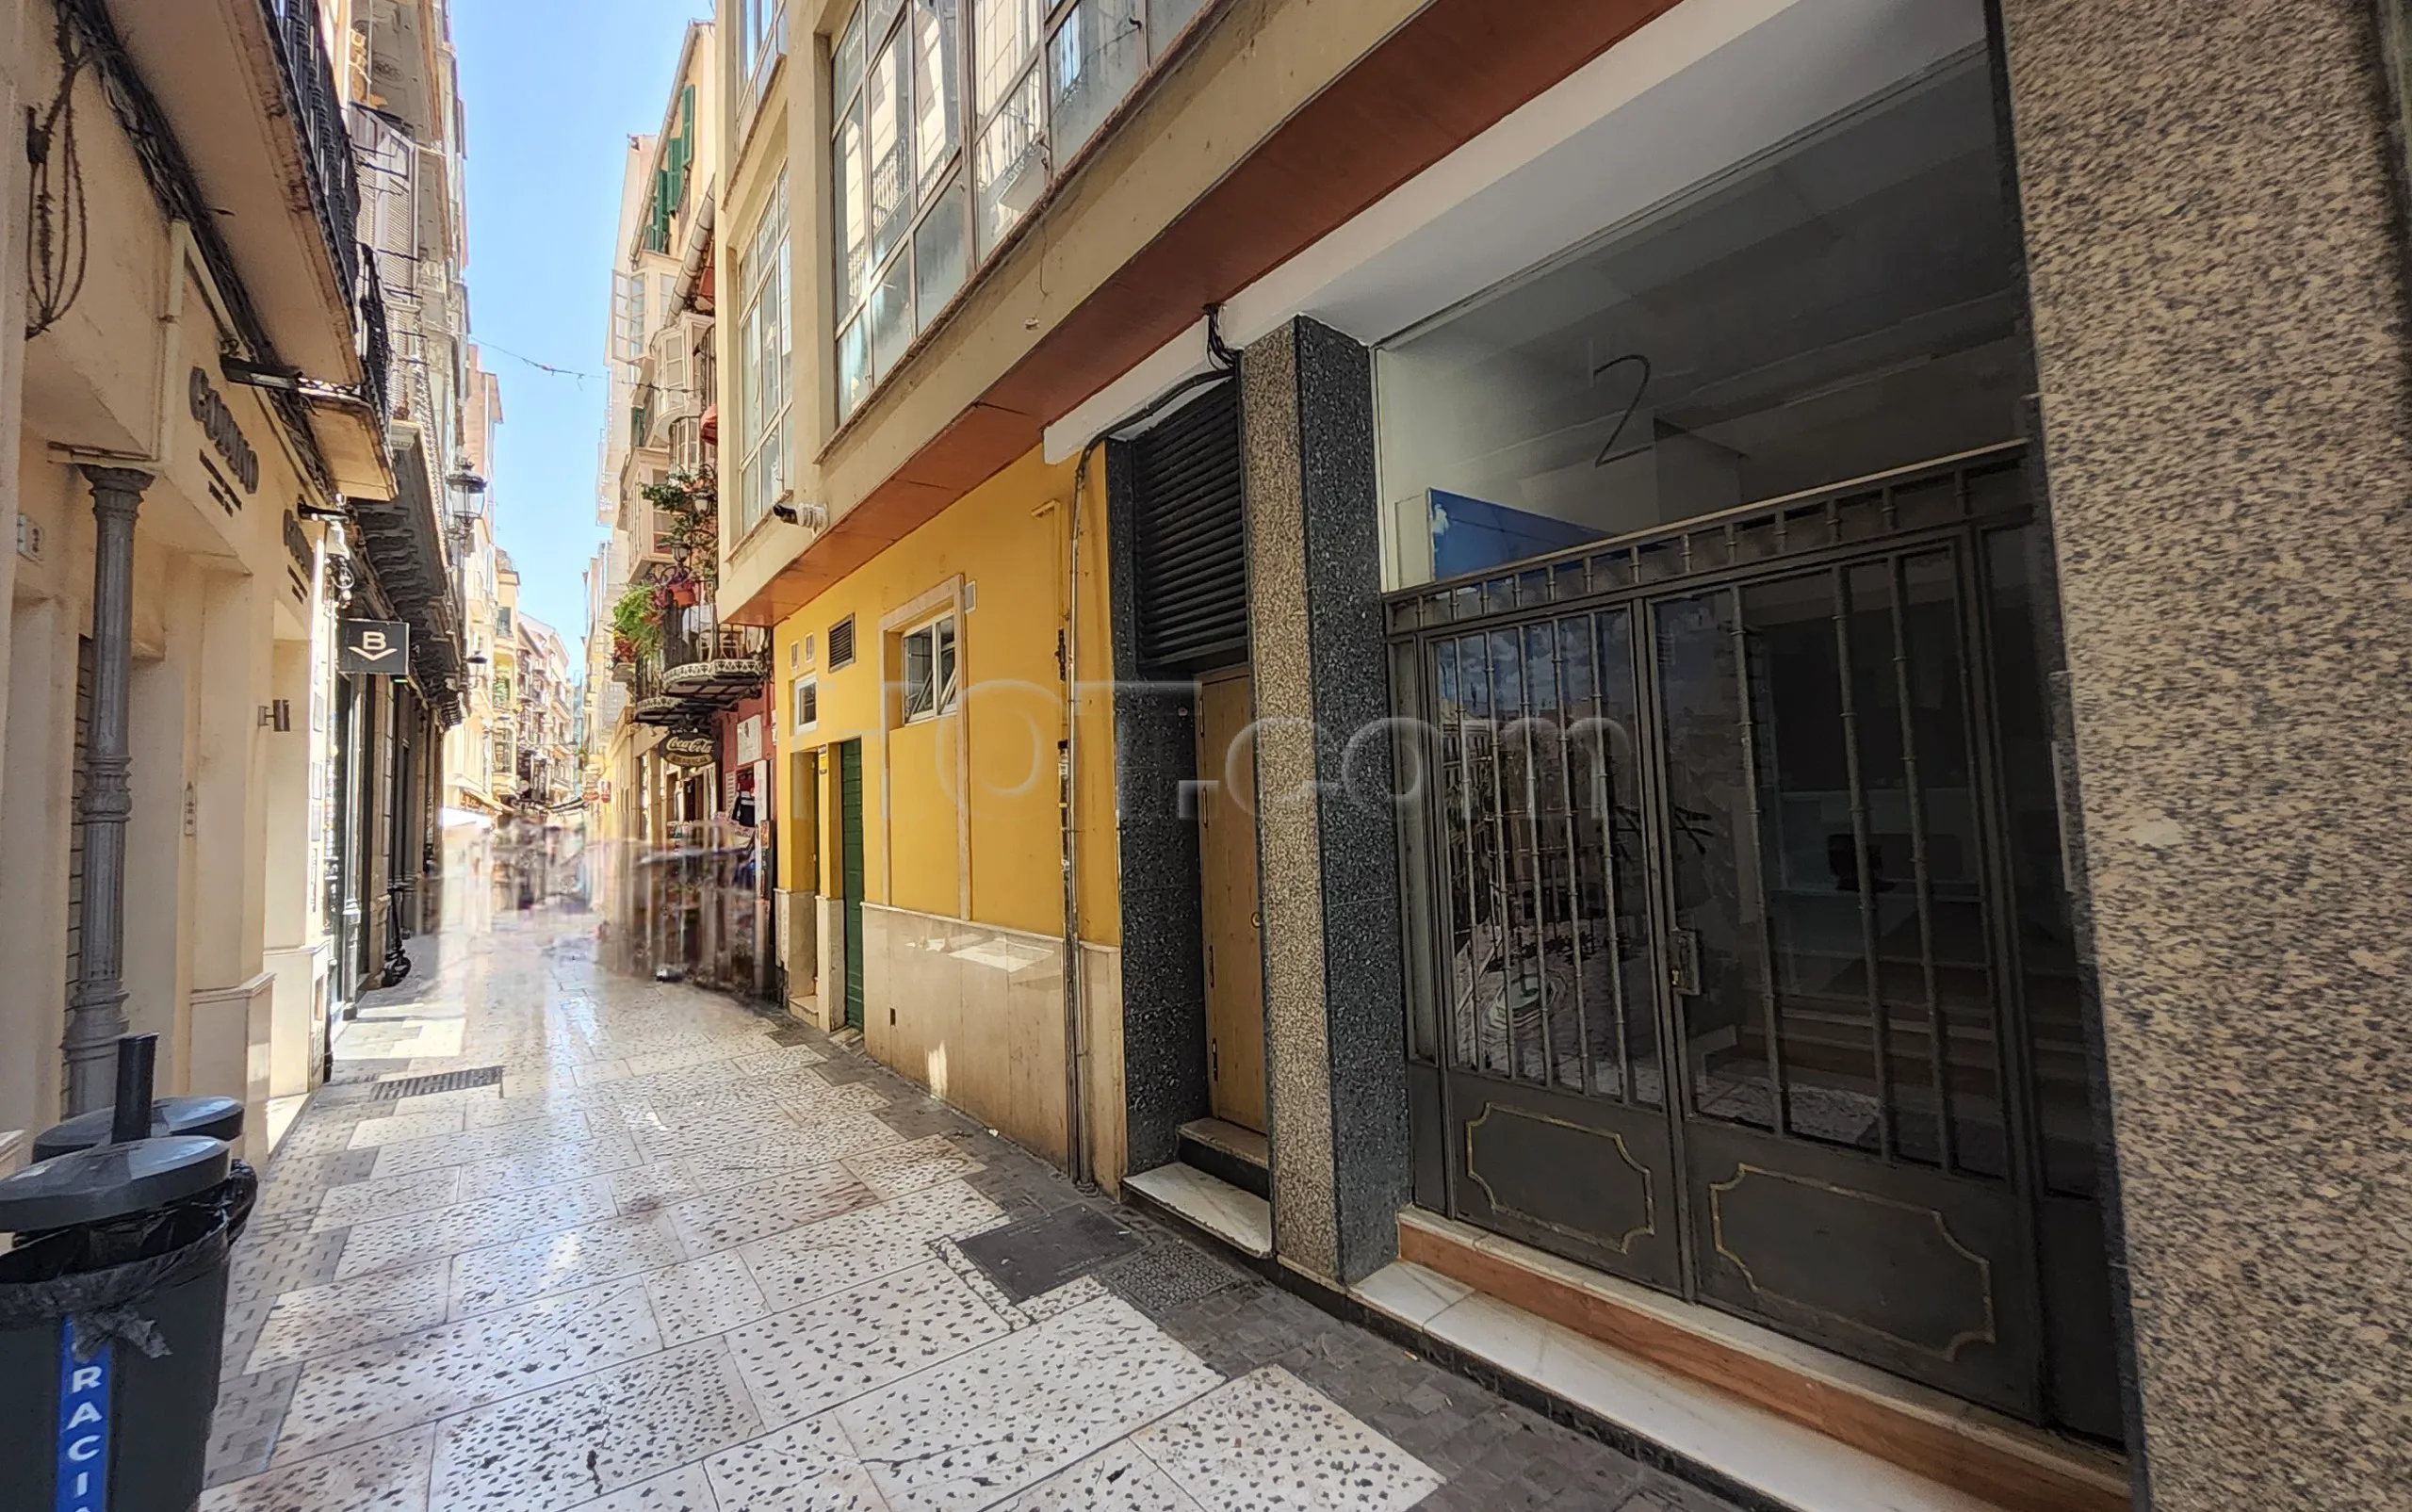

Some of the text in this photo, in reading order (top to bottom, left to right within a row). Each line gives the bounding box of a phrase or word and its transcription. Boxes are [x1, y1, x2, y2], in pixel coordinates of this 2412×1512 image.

[1592, 354, 1651, 468] 2
[363, 631, 387, 650] B
[66, 1341, 104, 1512] RACI
